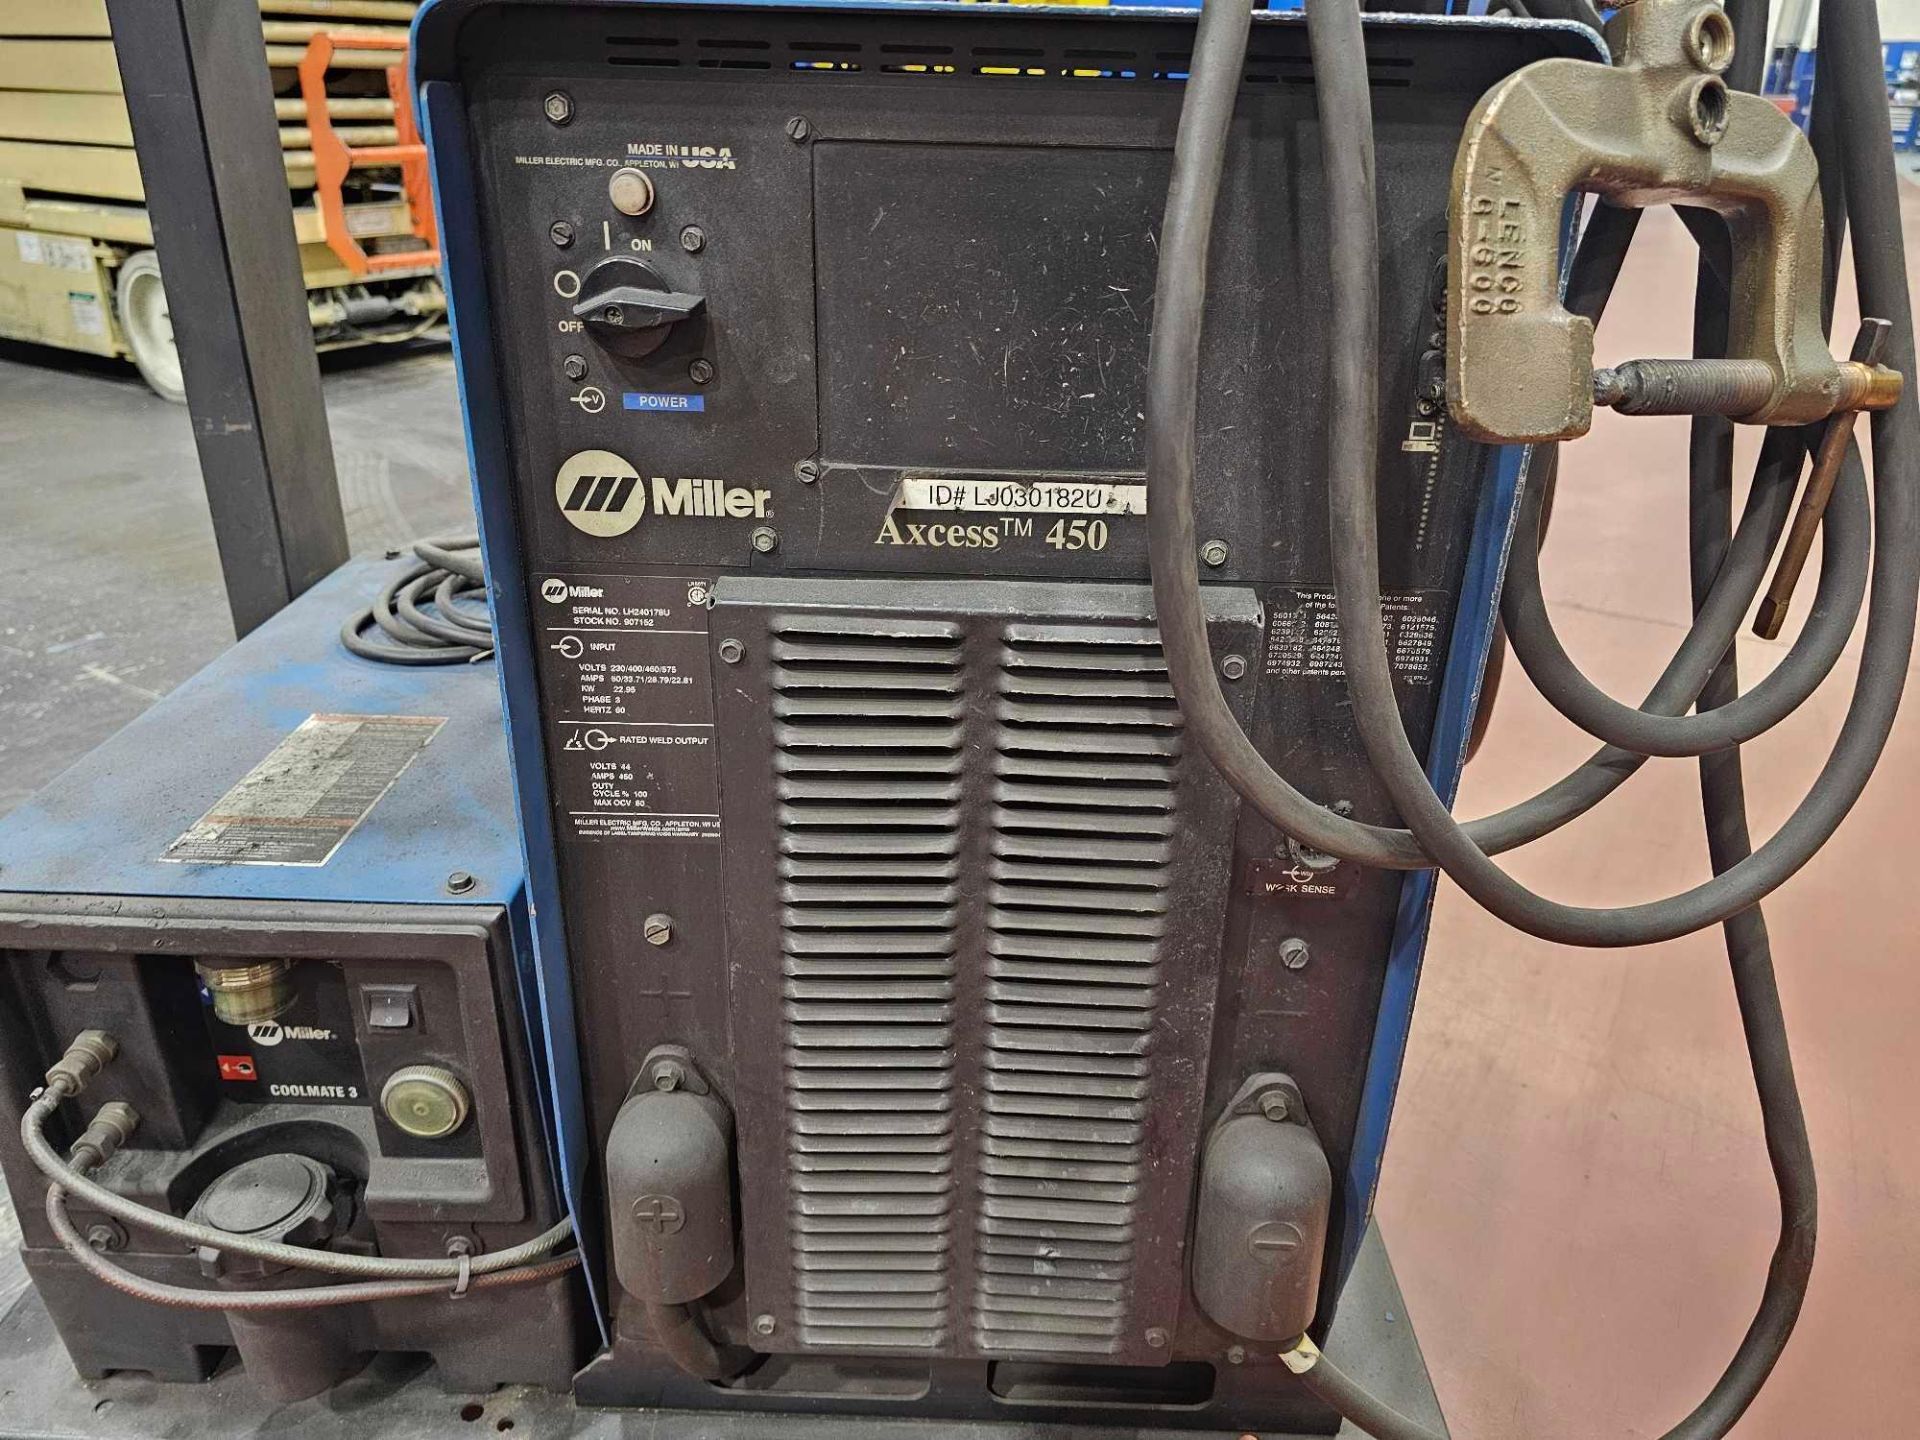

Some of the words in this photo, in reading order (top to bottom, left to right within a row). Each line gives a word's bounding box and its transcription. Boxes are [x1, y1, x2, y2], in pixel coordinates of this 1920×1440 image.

[515, 156, 545, 165] MILLER
[545, 156, 583, 166] ELECTRIC
[627, 143, 662, 156] MADE
[665, 144, 678, 156] IN
[680, 146, 736, 170] USA
[631, 238, 652, 252] ON
[1497, 196, 1527, 316] LENCO
[558, 320, 584, 333] OFF
[639, 396, 688, 408] POWER
[929, 485, 966, 506] ID#
[974, 486, 1102, 508] LJ030182U
[1045, 518, 1108, 551] 450
[568, 586, 603, 598] Miller
[1296, 592, 1312, 600] This
[572, 606, 603, 615] SERIAL
[605, 607, 620, 616] NO.
[573, 617, 604, 625] STOCK
[605, 617, 621, 626] NO.
[590, 643, 616, 651] INPUT
[578, 663, 607, 672] VOLTS
[582, 695, 611, 703] PHASE
[583, 706, 612, 714] HERTZ
[620, 735, 648, 744] RATED
[649, 736, 673, 744] WELD
[674, 737, 709, 745] OUTPUT
[590, 762, 617, 770] VOLTS
[591, 772, 615, 780] AMPS
[592, 790, 620, 798] CYCLE
[634, 790, 648, 798] 100
[613, 799, 631, 807] OCV
[574, 818, 598, 826] MILLER
[1301, 884, 1336, 895] SENSE
[284, 1026, 332, 1041] Miller
[270, 1083, 344, 1098] COOLMATE
[348, 1086, 358, 1098] 3
